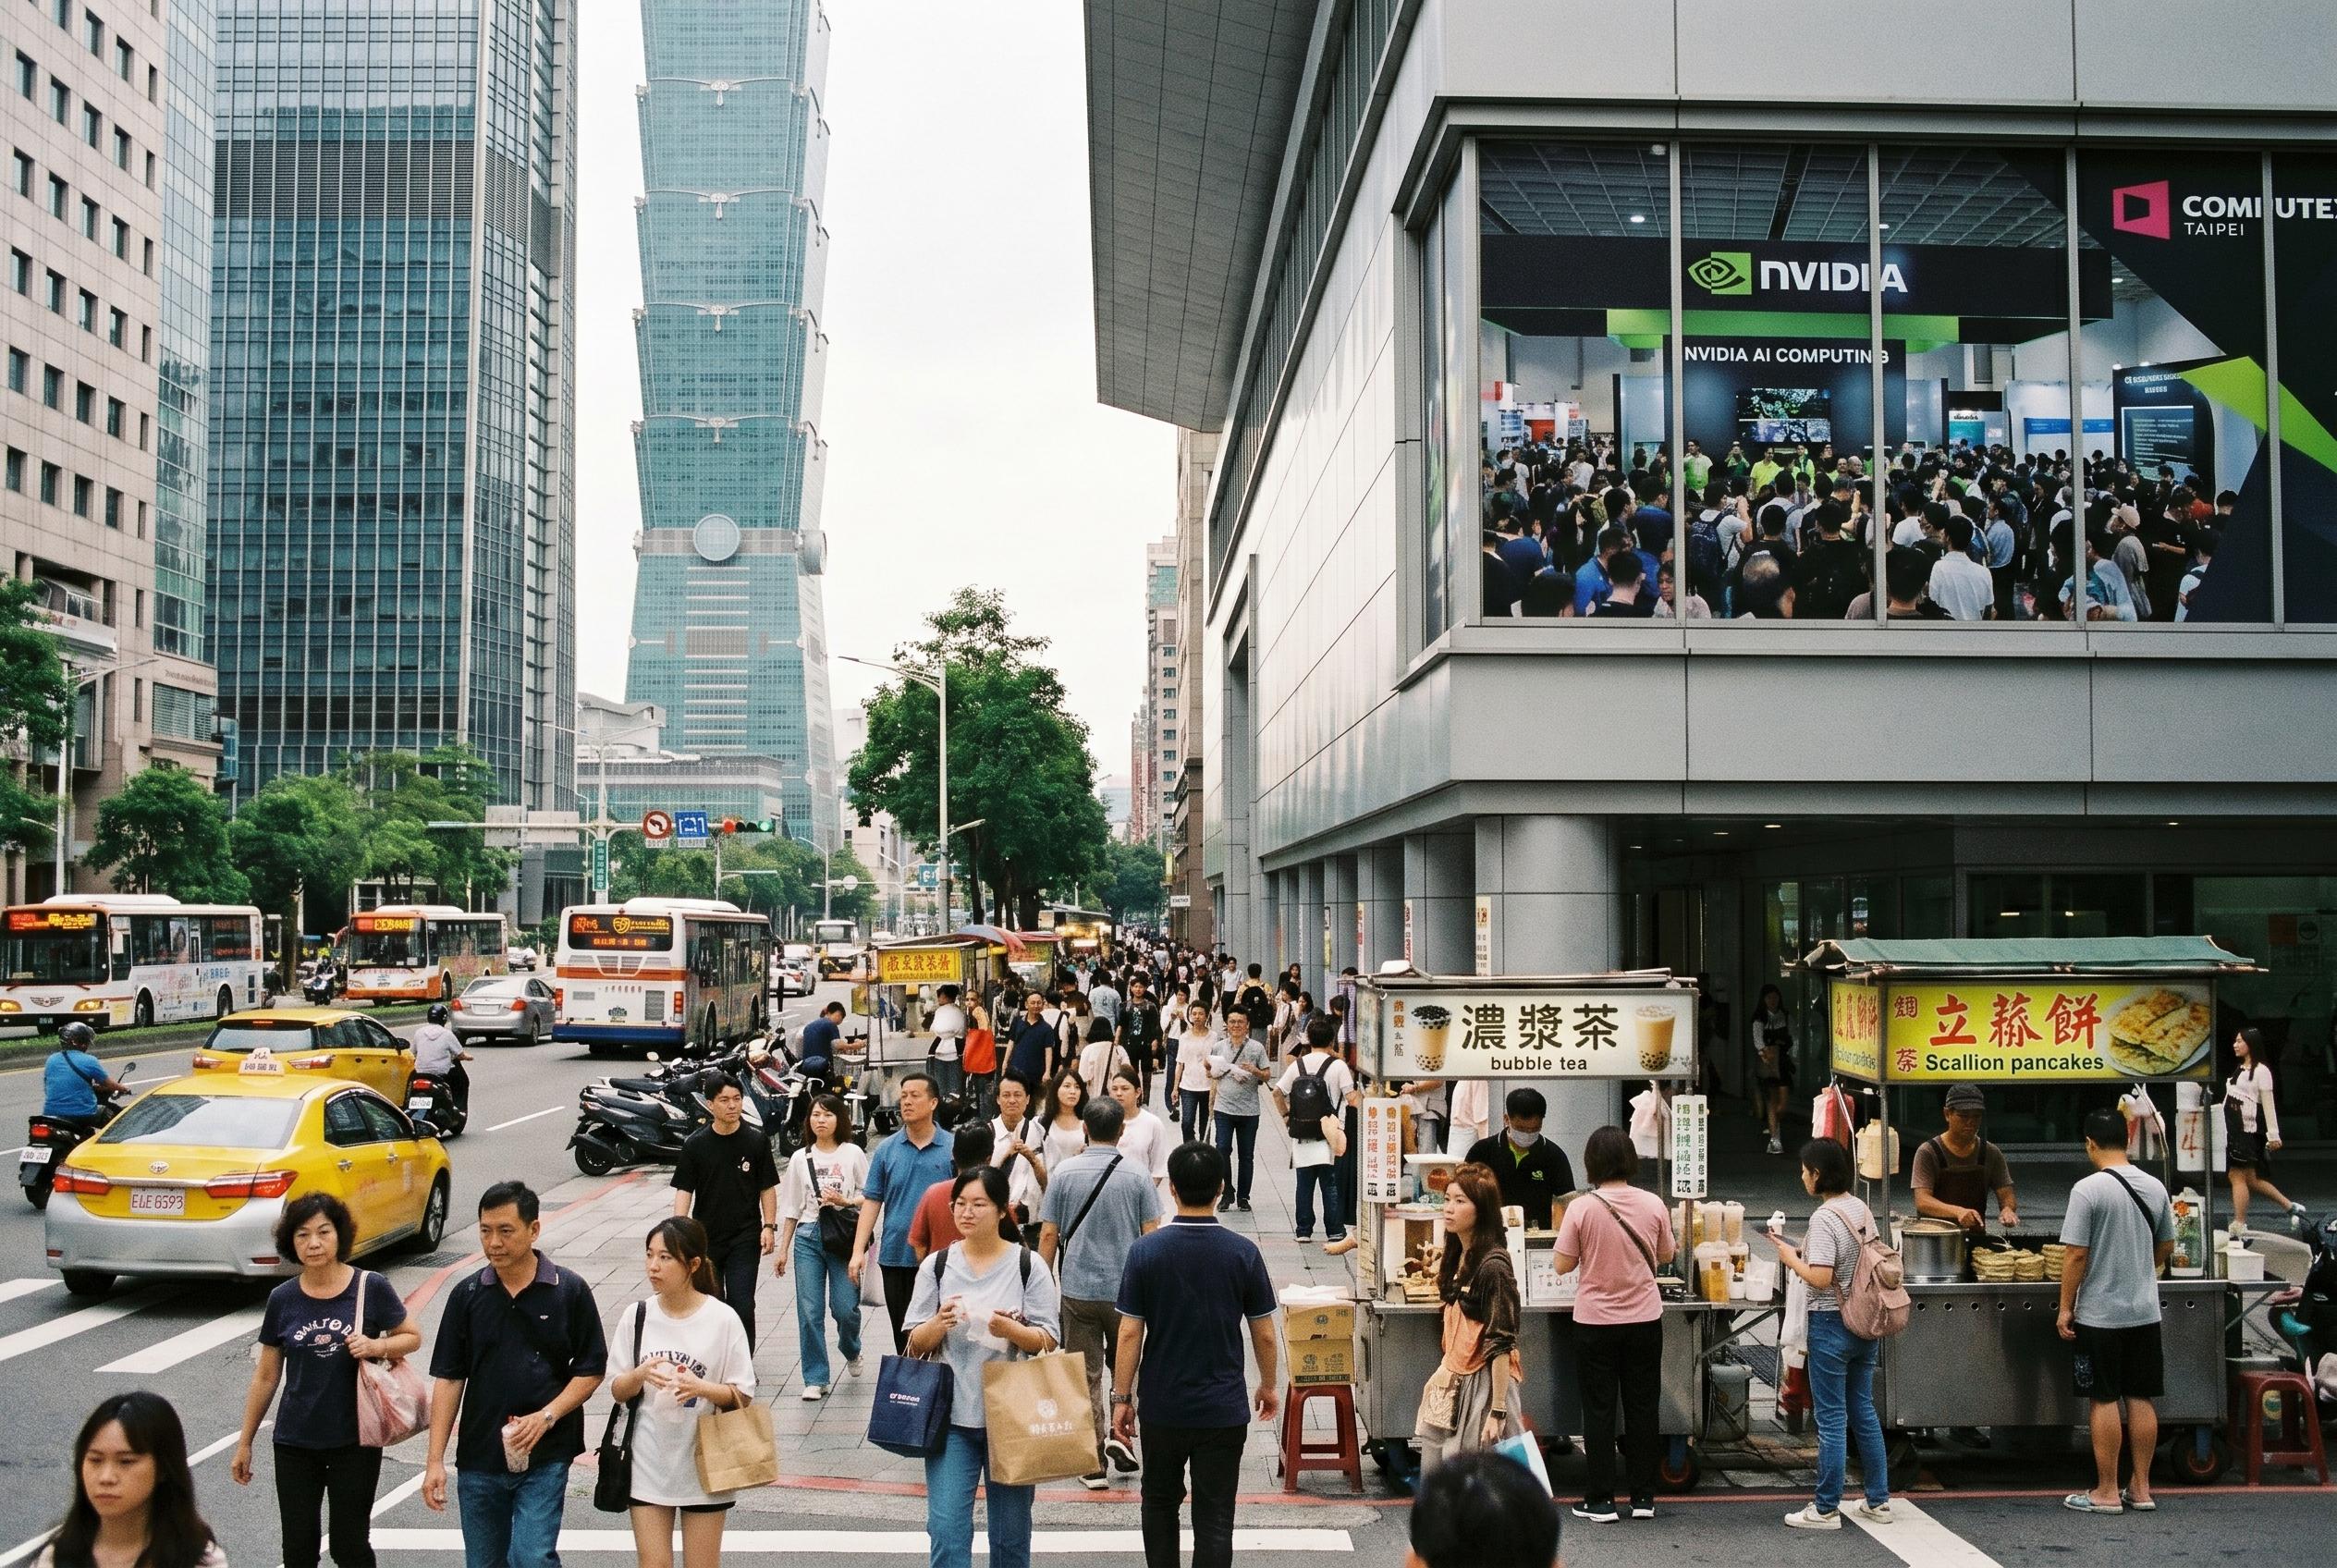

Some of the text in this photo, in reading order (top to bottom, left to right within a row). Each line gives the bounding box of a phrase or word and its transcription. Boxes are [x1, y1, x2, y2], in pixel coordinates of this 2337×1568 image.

[2184, 222, 2245, 237] TAIPEI
[1684, 346, 1751, 362] NVIDIA
[1753, 348, 1770, 362] AI
[1462, 1003, 1620, 1051] 濃漿茶
[1490, 1056, 1587, 1071] bubble tea
[1926, 1053, 2104, 1074] Scallion pancakes
